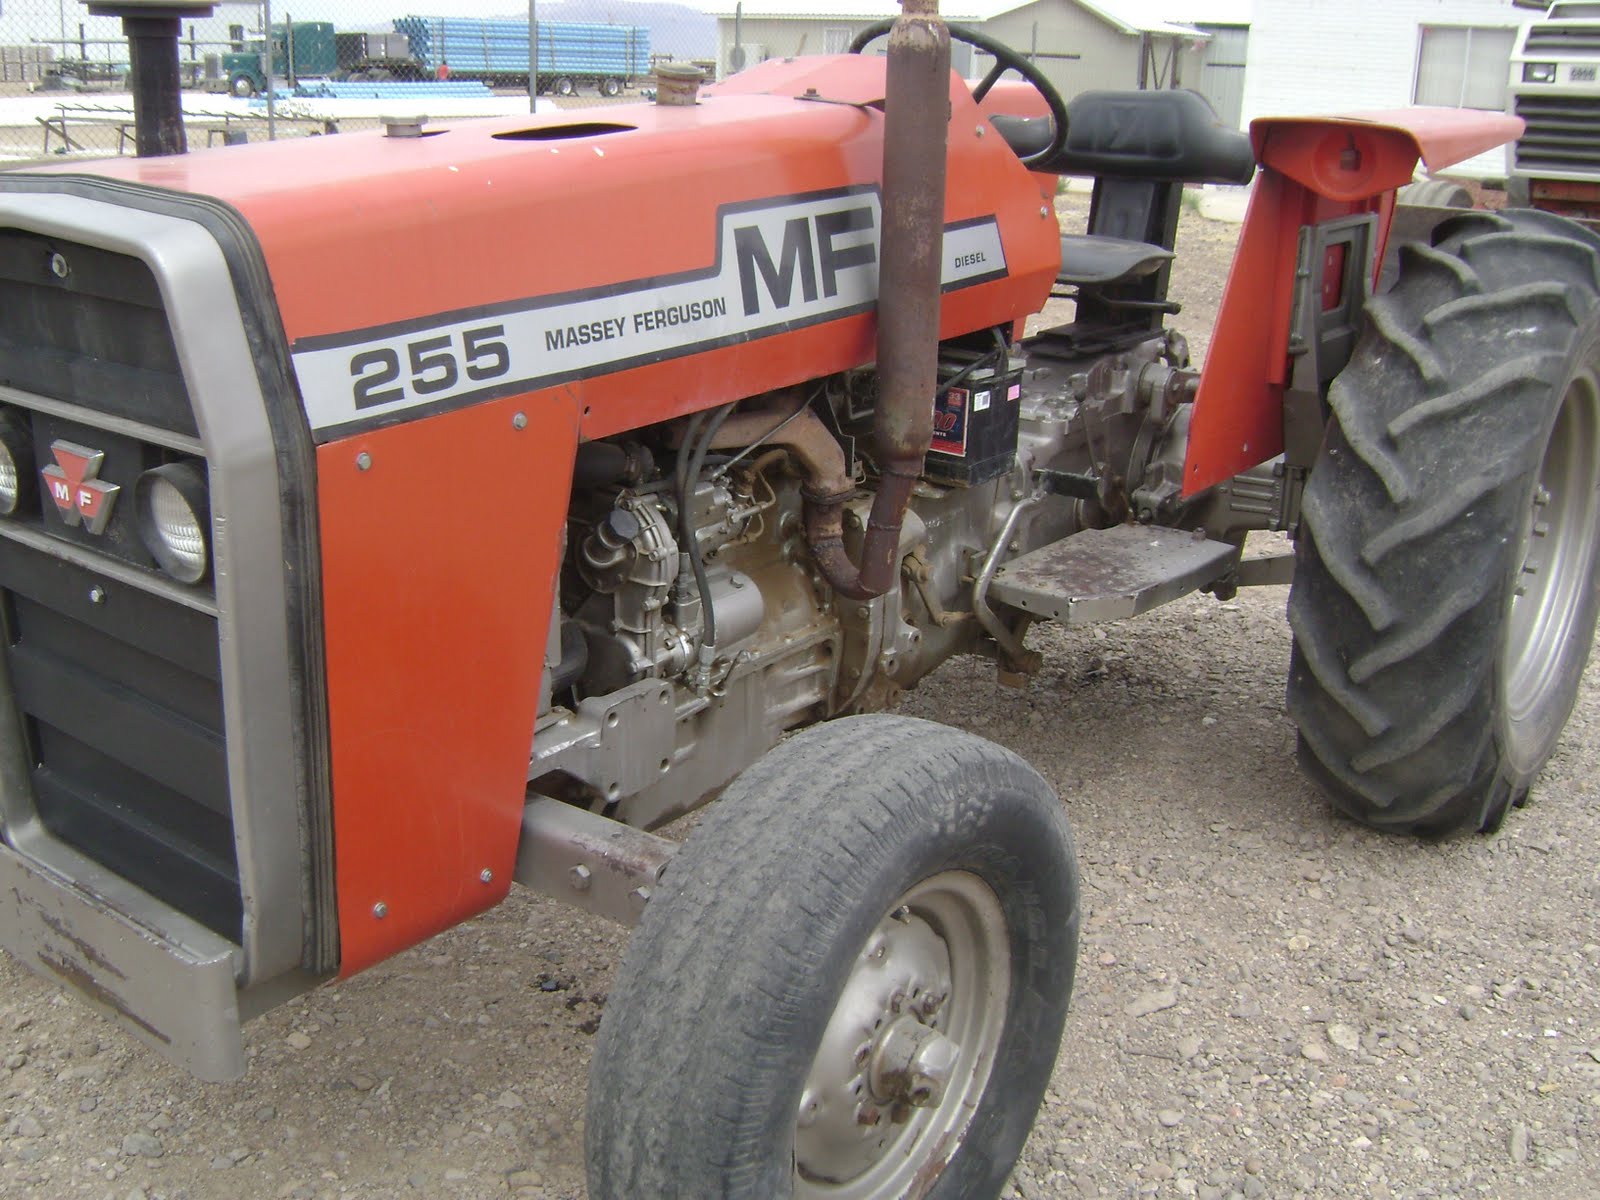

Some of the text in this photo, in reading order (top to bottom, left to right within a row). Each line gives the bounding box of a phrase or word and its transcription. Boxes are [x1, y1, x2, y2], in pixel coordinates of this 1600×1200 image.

[734, 206, 876, 317] MF
[954, 252, 986, 268] DIESEL
[350, 297, 727, 410] 255 MASSEY FERGUSON
